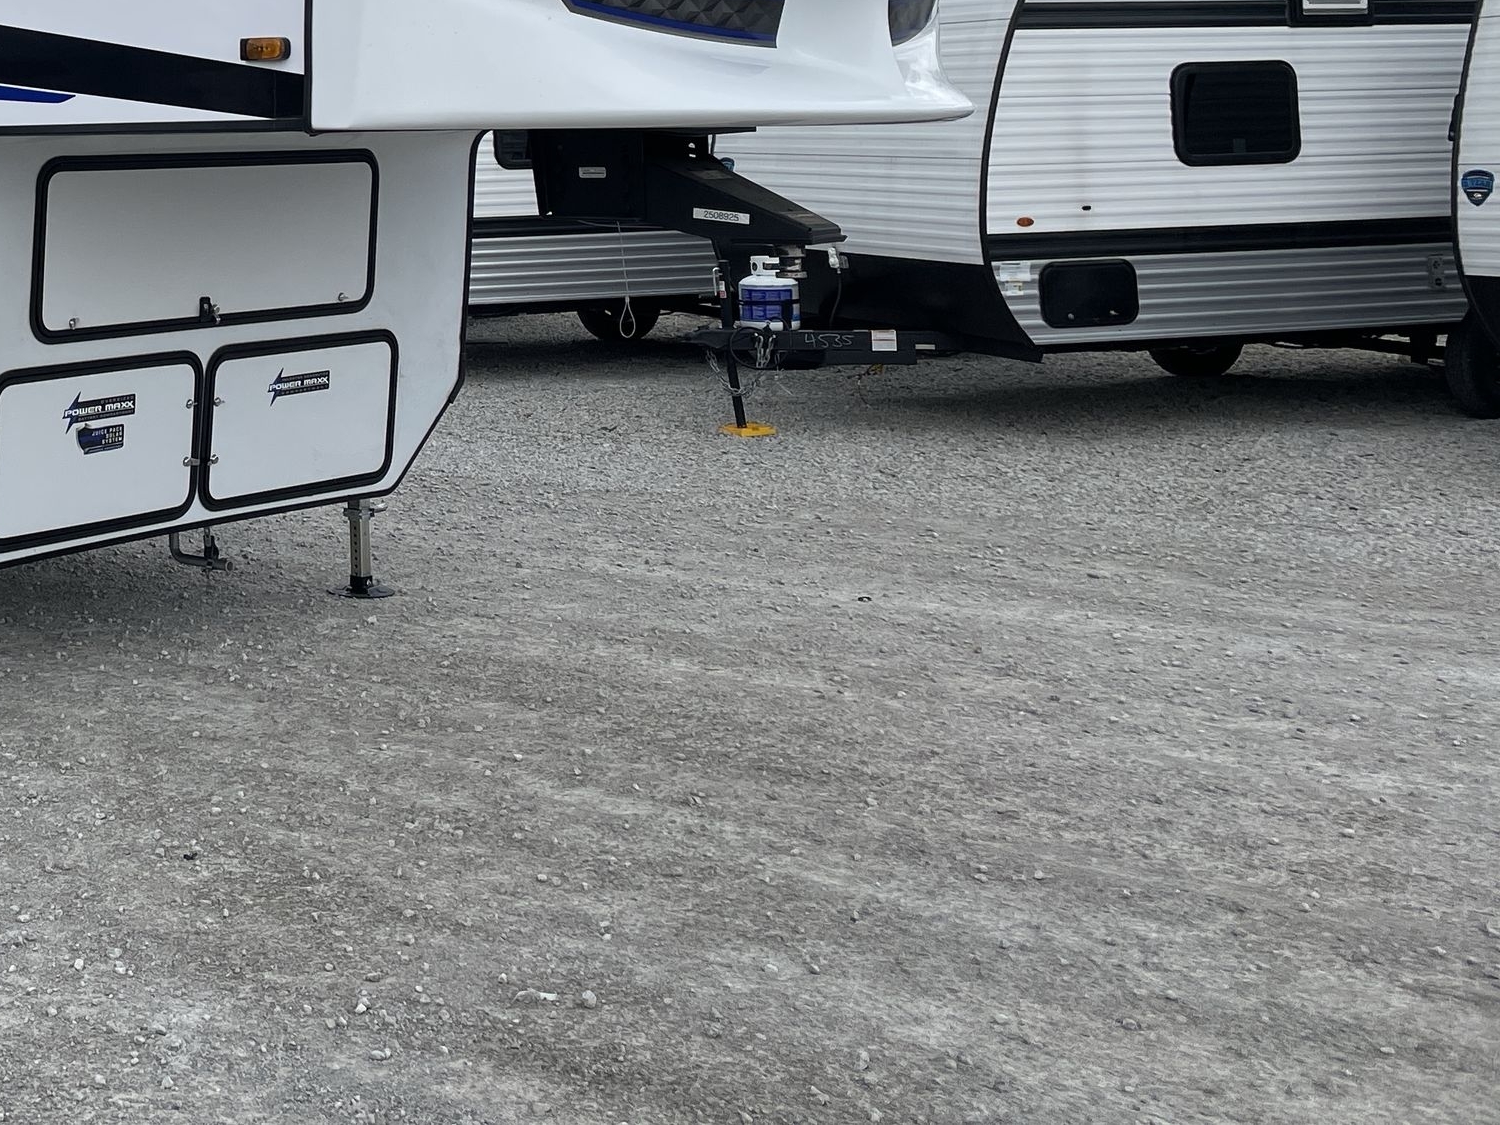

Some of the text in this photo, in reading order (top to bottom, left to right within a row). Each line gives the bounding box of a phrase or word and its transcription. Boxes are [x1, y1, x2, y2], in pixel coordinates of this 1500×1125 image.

[703, 210, 739, 222] 2508925
[269, 381, 302, 391] POWER
[64, 405, 102, 417] POWER
